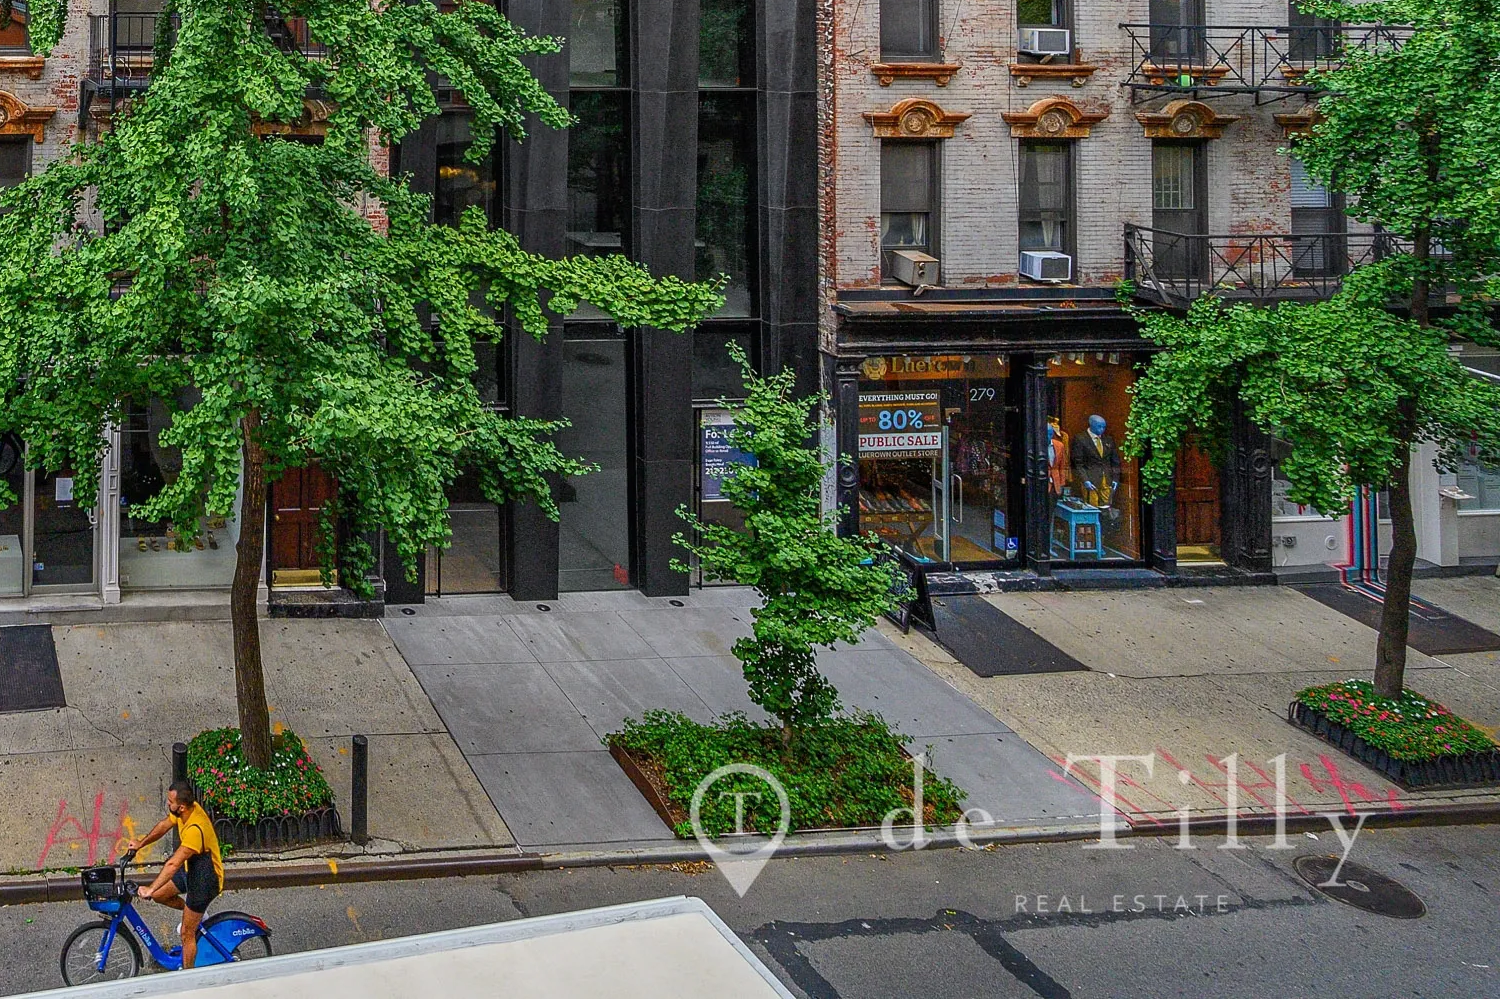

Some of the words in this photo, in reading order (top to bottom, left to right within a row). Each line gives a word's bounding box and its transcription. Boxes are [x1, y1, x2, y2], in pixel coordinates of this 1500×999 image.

[858, 394, 904, 402] EVERYTHING
[905, 393, 925, 401] MUST
[925, 392, 938, 400] GO!
[969, 387, 995, 402] 279
[878, 409, 924, 430] 80%
[859, 436, 905, 448] PUBLIC
[907, 435, 939, 446] SALE
[858, 451, 891, 459] LUEROWN
[892, 450, 917, 458] OUTLET
